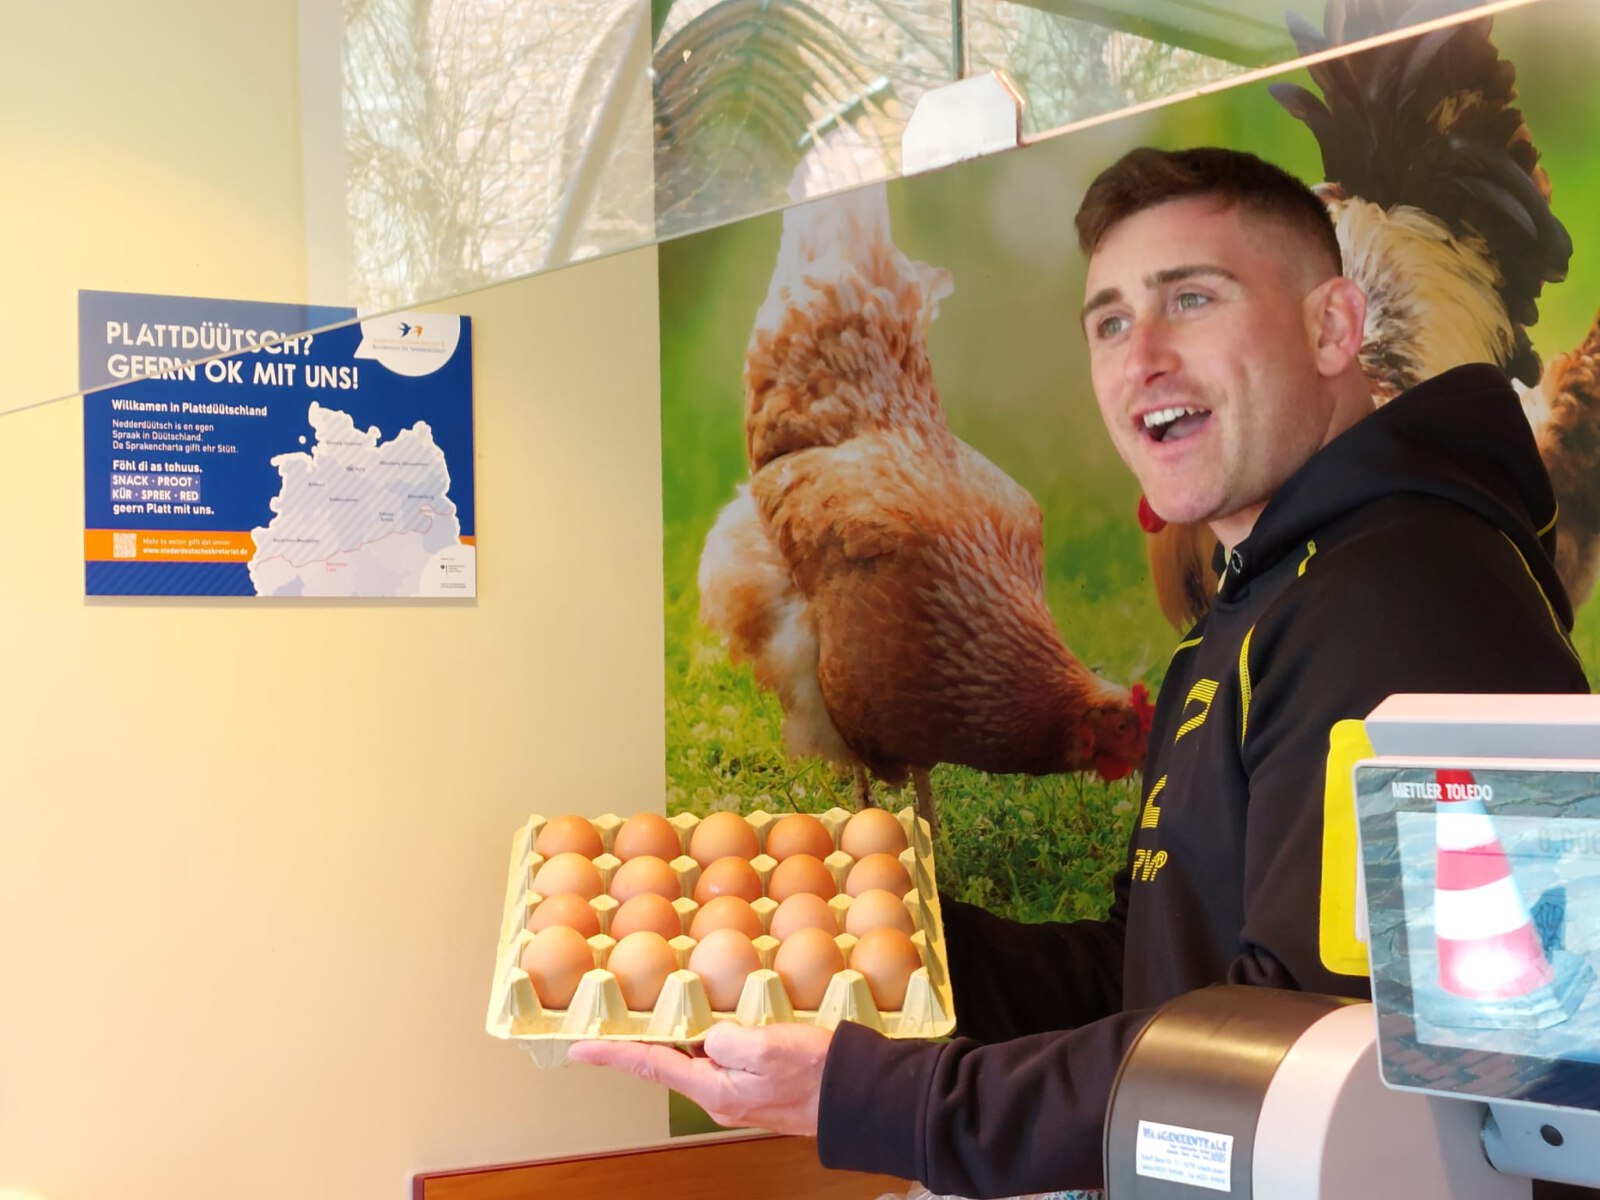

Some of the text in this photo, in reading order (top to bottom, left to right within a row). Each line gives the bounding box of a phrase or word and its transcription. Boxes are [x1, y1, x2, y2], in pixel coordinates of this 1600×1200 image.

[106, 321, 314, 355] PLATTDÜÜTSCH?
[107, 354, 358, 390] GEERN OK MIT UNS!
[111, 399, 268, 417] Willkamen in Plattdüütschland
[112, 419, 173, 430] Nedderdüütsch
[174, 421, 182, 431] is
[112, 430, 203, 442] Spraak in Düütschland.
[112, 441, 124, 450] De
[125, 441, 183, 453] Sprakencharta
[202, 444, 216, 453] ehr
[112, 460, 203, 473] Föhl di as tohuus.
[112, 475, 193, 487] SNACK PROOT
[112, 487, 199, 501] KÜR SPREK RED
[113, 503, 215, 516] geern Platt mit uns.
[1392, 782, 1494, 801] METTLER TOLEDO
